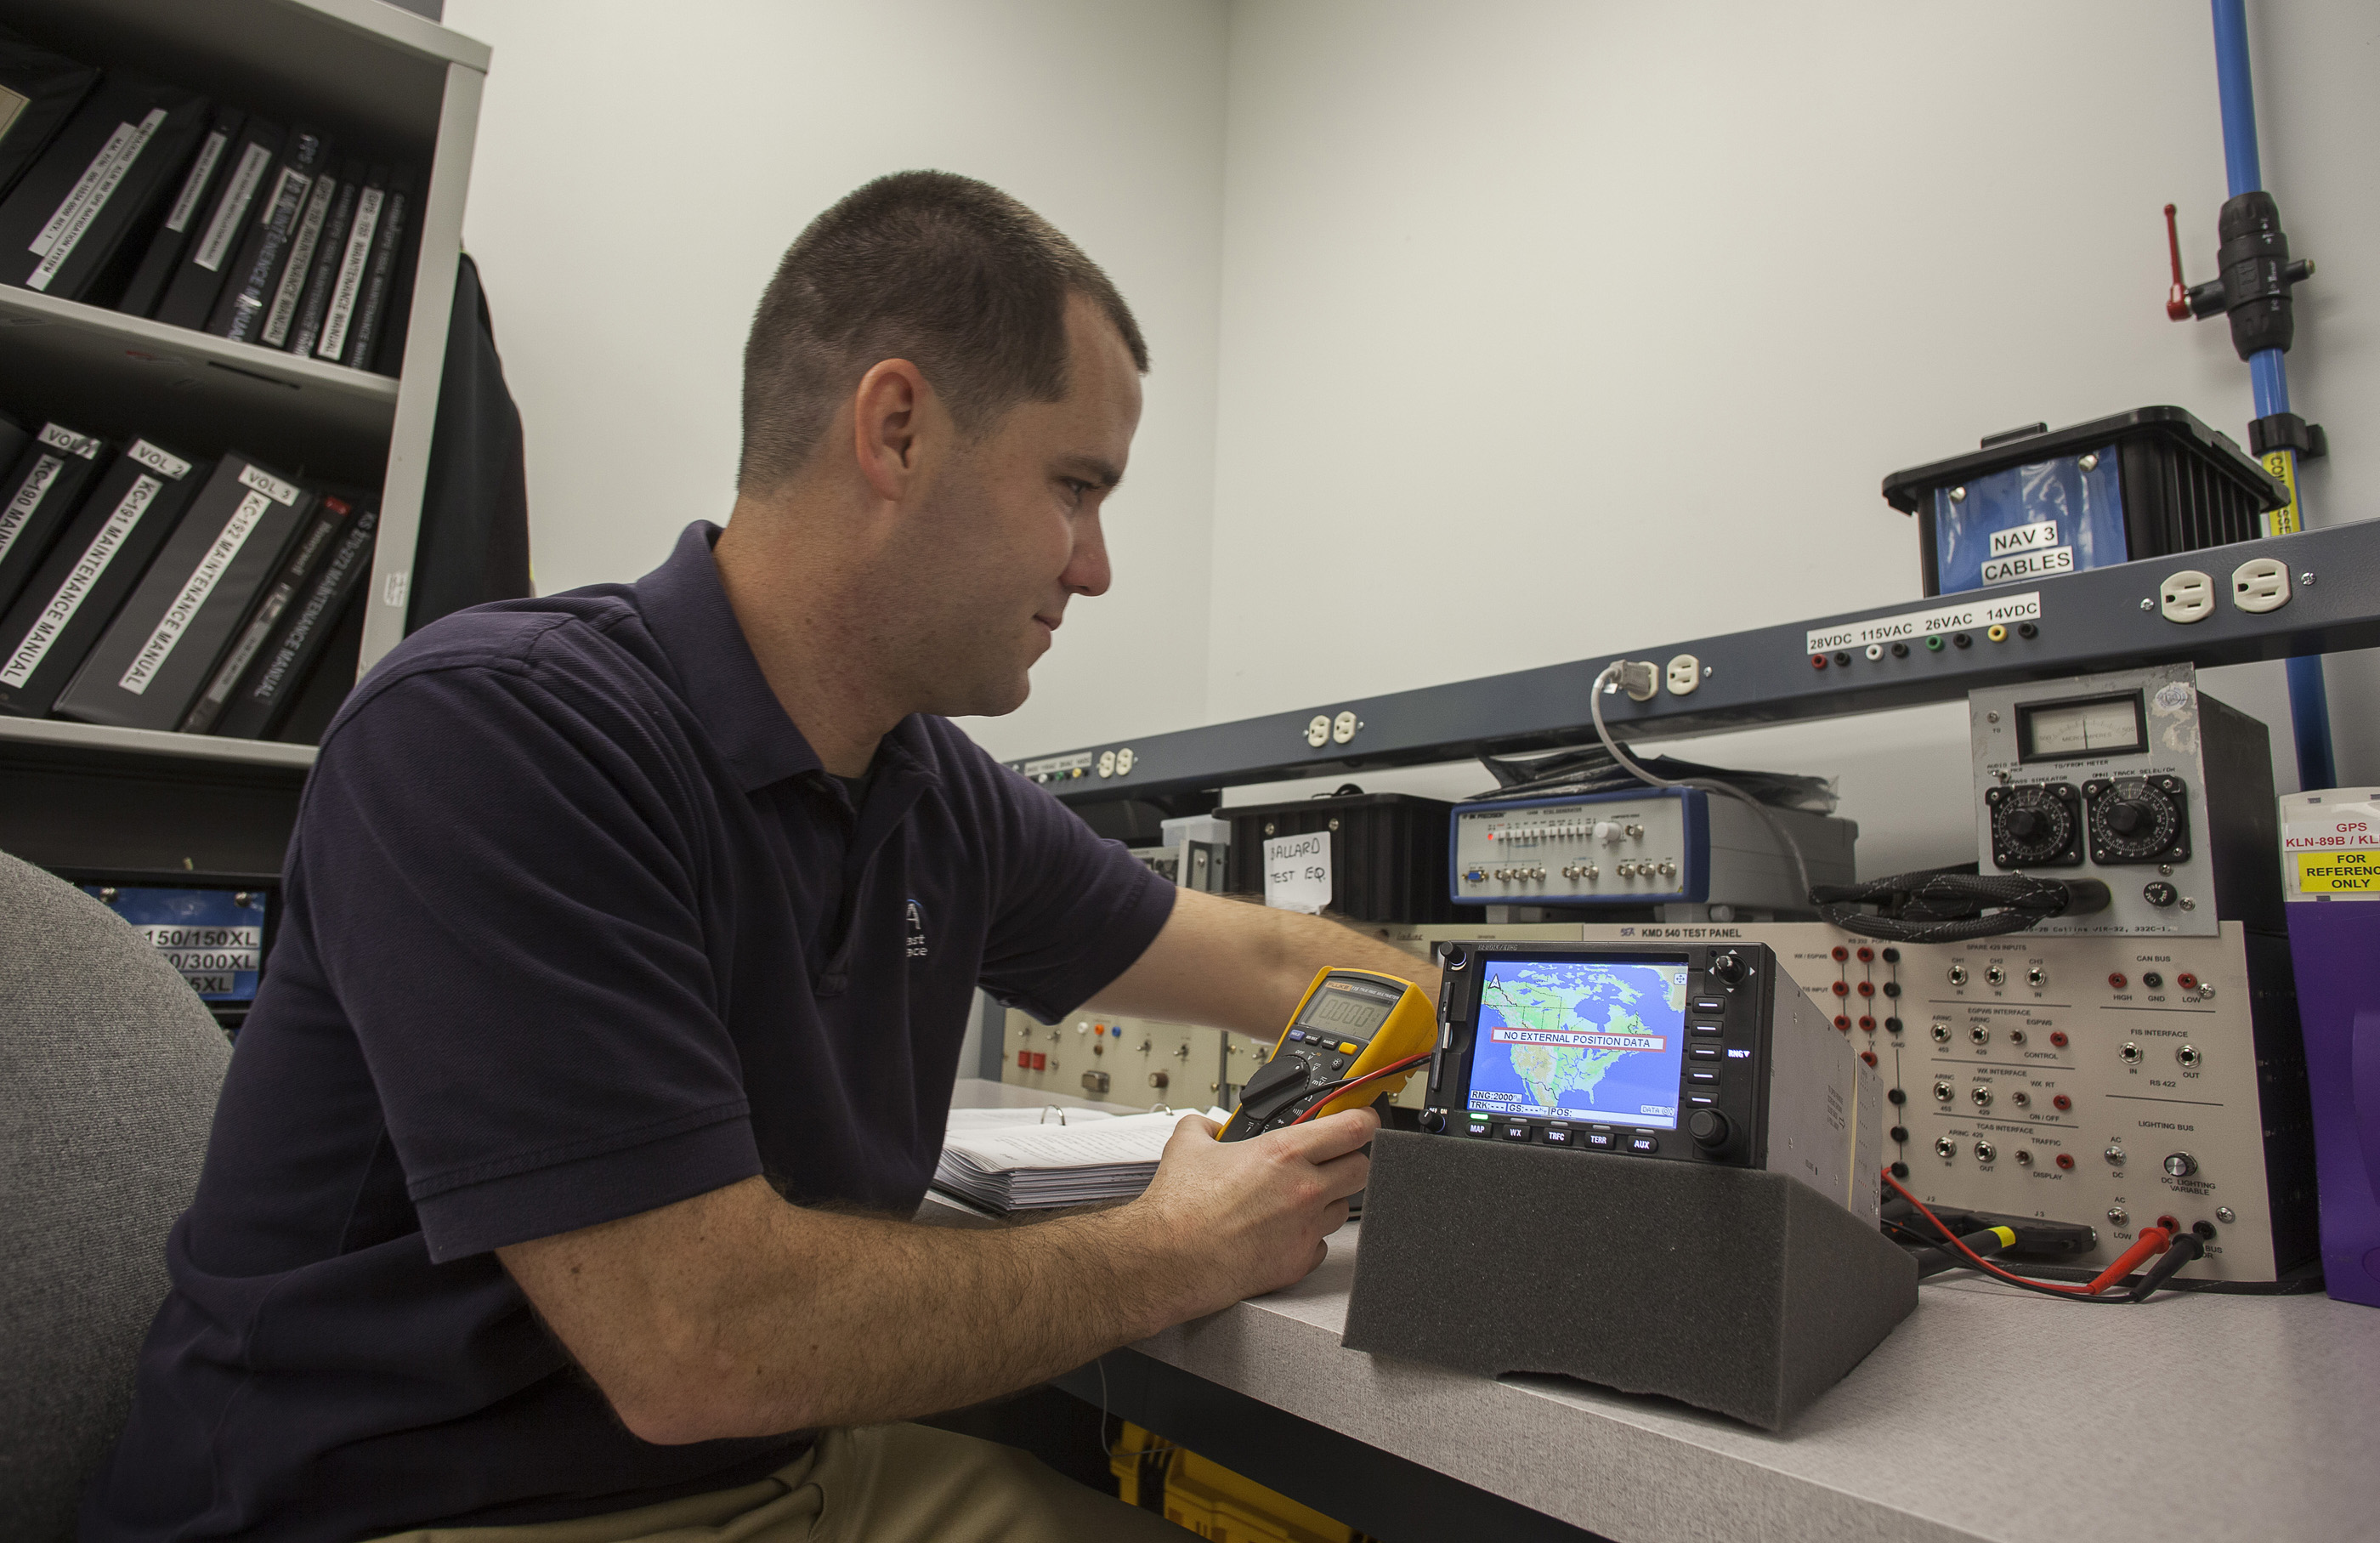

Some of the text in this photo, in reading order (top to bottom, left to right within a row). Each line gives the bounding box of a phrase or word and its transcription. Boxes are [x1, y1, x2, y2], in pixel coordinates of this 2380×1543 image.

[61, 207, 94, 247] NAVIGATION
[43, 247, 65, 274] SYSTEM
[284, 227, 315, 297] MAINTENANCE
[337, 241, 365, 309] MAINTENANCE
[269, 298, 292, 339] MANUAL
[326, 313, 345, 354] MANUAL
[48, 429, 81, 450] VOL
[139, 446, 184, 477] VOL 2
[17, 460, 57, 506] KC-190
[249, 473, 292, 500] VOL 3
[289, 519, 332, 576] Honeywell
[1995, 527, 2055, 551] NAV 3
[1985, 553, 2071, 580] CABLES
[2, 479, 154, 682] KC-191 MAINTENANCE MANUAL
[126, 495, 263, 688] KC-192 MAINTENANCE MANUAL
[284, 565, 343, 651] MAINTENANCE
[1810, 603, 2037, 650] 28VDC 115VAC 26VAC 14VDC
[253, 646, 294, 701] MANUAL
[2336, 822, 2367, 832] GPS
[2286, 836, 2354, 847] KLN-89B /
[2337, 854, 2366, 864] FOR
[2332, 879, 2371, 888] ONLY
[1641, 928, 1742, 939] KMD 540 TEST PANEL
[1376, 990, 1399, 1000] MULTIMETER
[1521, 1032, 1570, 1043] EXTERNAL
[1572, 1035, 1621, 1046] POSITION
[1624, 1037, 1650, 1047] DATA
[1728, 1049, 1743, 1058] RNG
[1990, 1069, 2027, 1077] INTERFACE
[1550, 1108, 1572, 1116] POS:
[1996, 1126, 2034, 1134] INTERFACE
[2139, 1120, 2175, 1130] LIGHTING
[1470, 1125, 1650, 1149] MAP WX TRFC TERR AUX
[2032, 1137, 2061, 1146] TRAFFIC
[2033, 1171, 2062, 1180] DISPLAY
[2177, 1179, 2216, 1189] LIGHTING
[2170, 1185, 2210, 1196] VARIABLE
[2205, 1245, 2223, 1253] BUS
